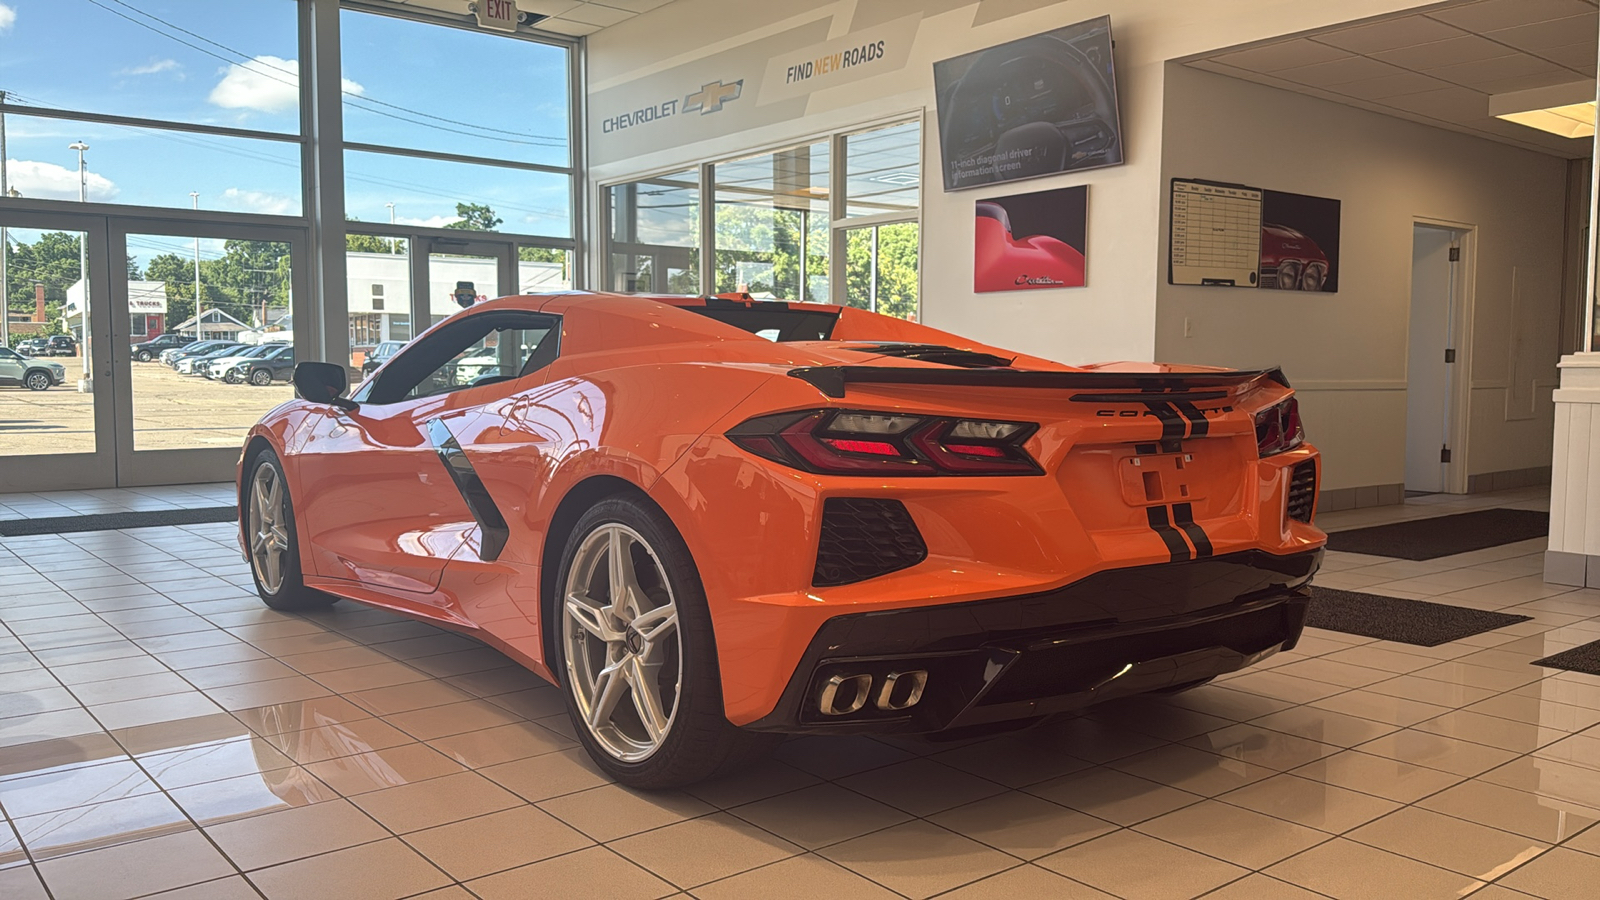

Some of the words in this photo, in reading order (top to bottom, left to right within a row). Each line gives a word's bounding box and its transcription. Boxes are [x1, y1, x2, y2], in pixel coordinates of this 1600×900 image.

[487, 0, 511, 21] EXIT
[786, 61, 813, 84] FIND
[813, 52, 843, 77] NEW
[842, 40, 885, 69] ROADS
[602, 99, 679, 134] CHEVROLET
[951, 159, 976, 169] 11-inch
[977, 152, 1009, 165] diagonal
[1009, 147, 1033, 160] driver
[951, 167, 995, 179] information
[995, 161, 1021, 174] screen
[449, 293, 487, 302] TKS
